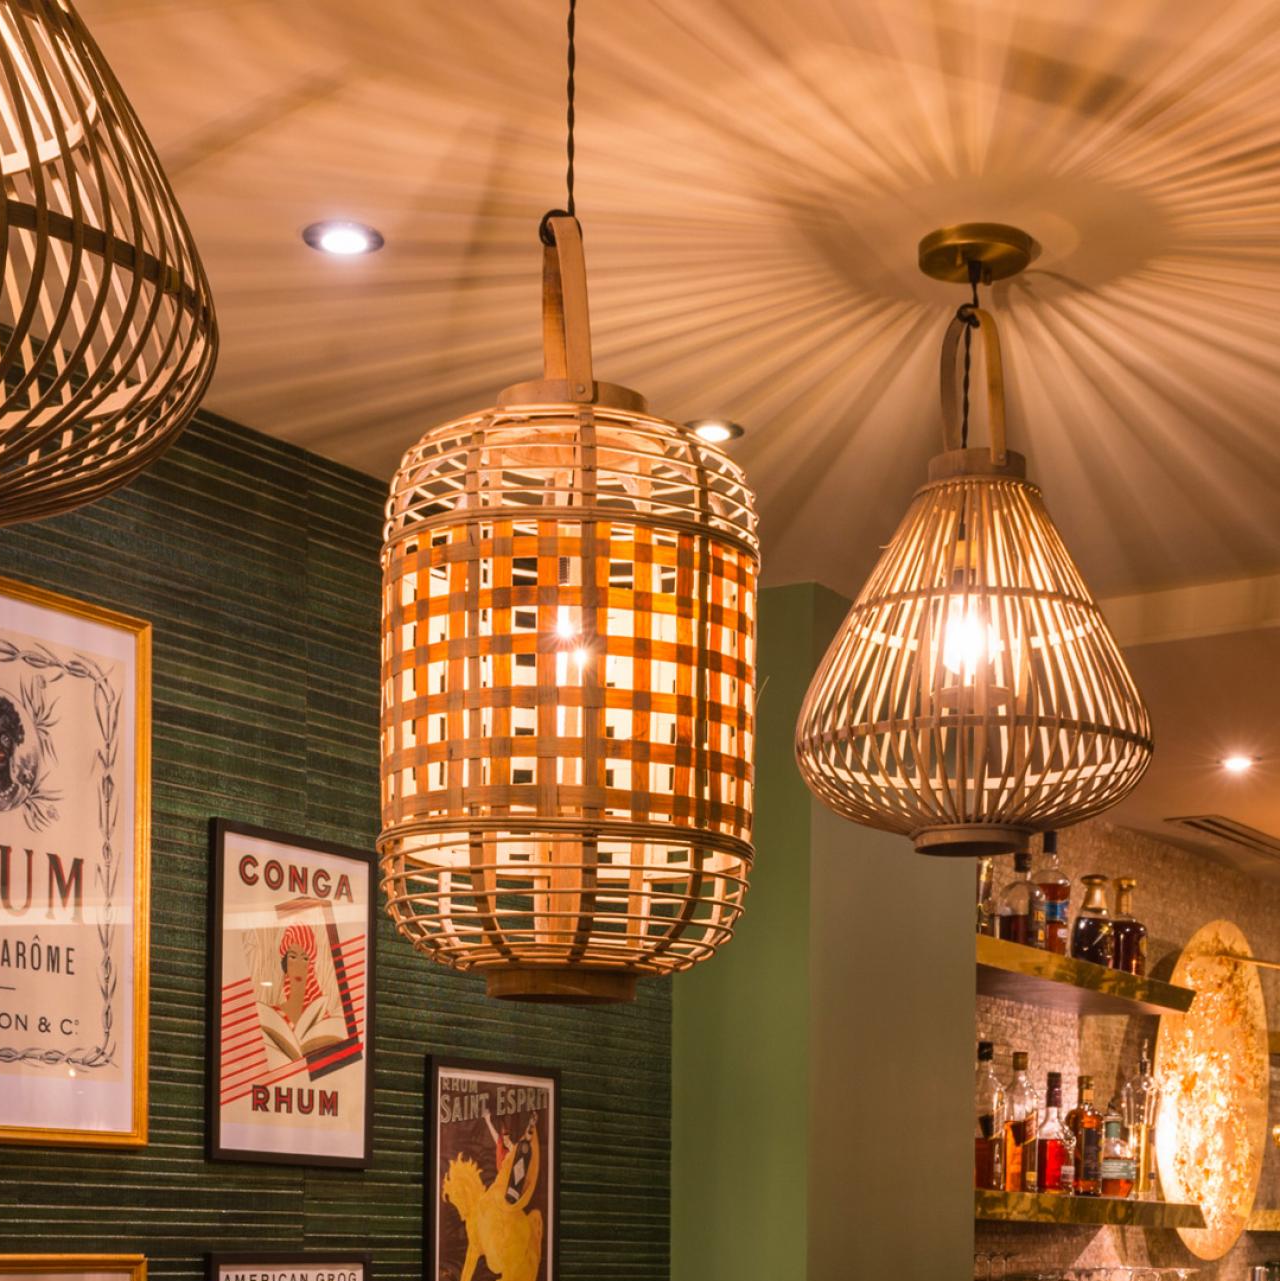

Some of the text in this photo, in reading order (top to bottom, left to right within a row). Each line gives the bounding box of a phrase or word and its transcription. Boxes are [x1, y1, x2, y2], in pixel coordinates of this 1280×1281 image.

[238, 854, 354, 903] CONGA
[0, 935, 75, 975] ARÔME
[38, 1017, 51, 1033] &
[442, 1077, 478, 1093] RHUM
[251, 1085, 339, 1117] RHUM
[440, 1093, 489, 1123] SAINT
